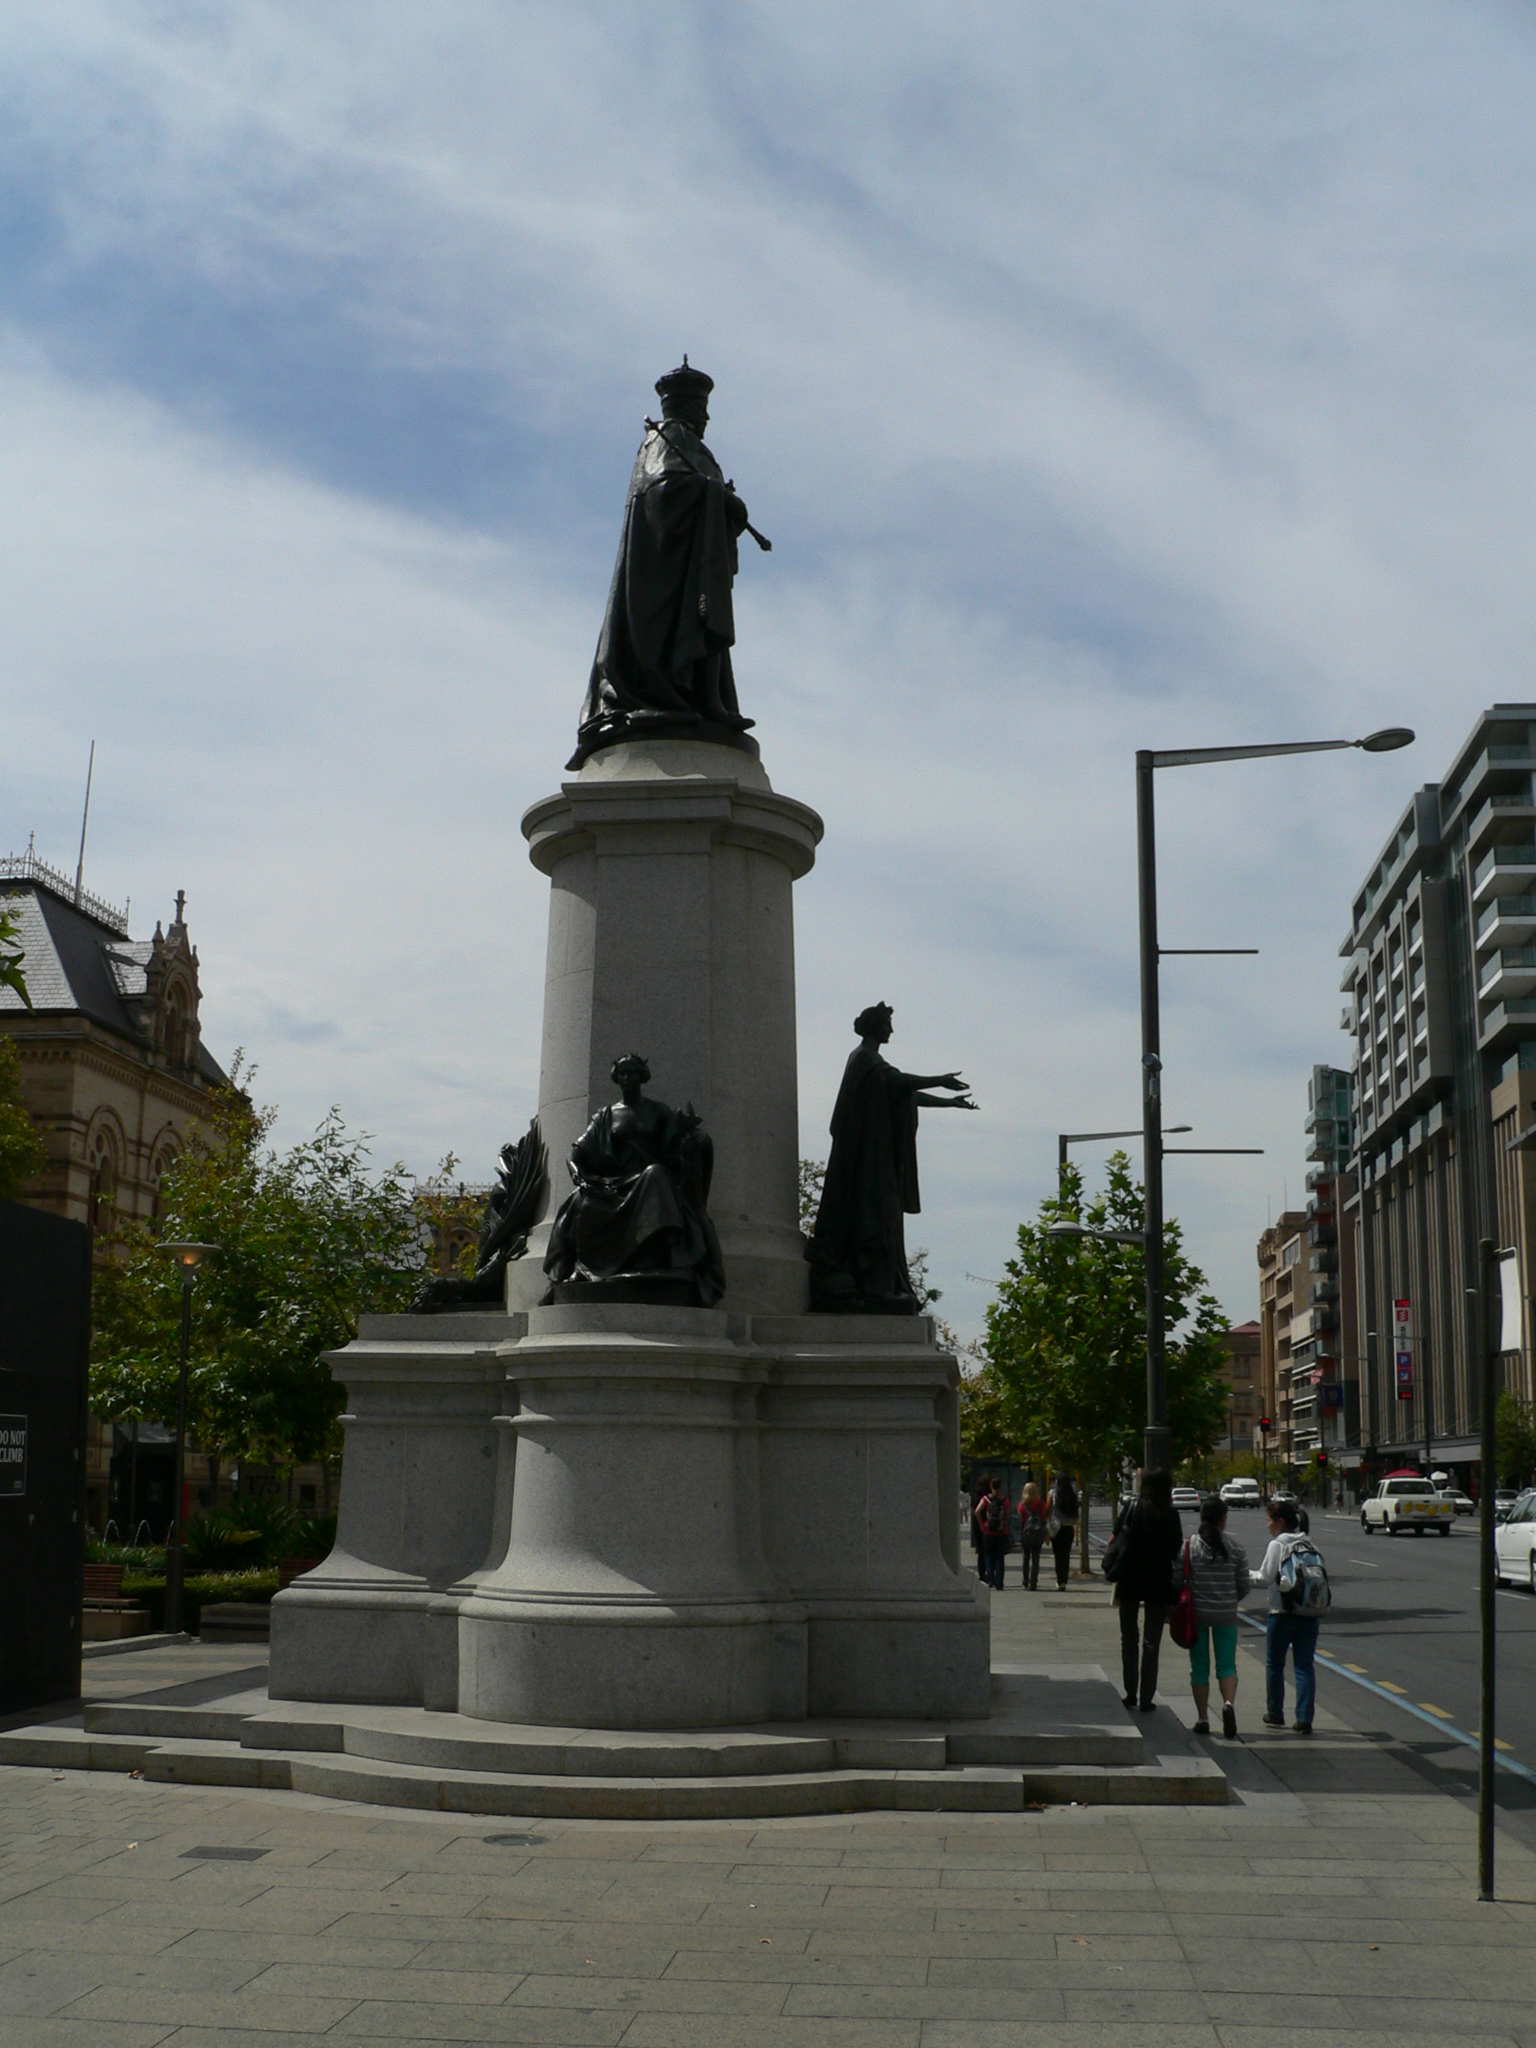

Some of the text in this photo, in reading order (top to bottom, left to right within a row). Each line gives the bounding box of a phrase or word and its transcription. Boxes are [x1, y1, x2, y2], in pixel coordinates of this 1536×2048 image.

[1400, 1356, 1408, 1364] P
[10, 1430, 27, 1446] NOT
[0, 1447, 24, 1463] CLIMB
